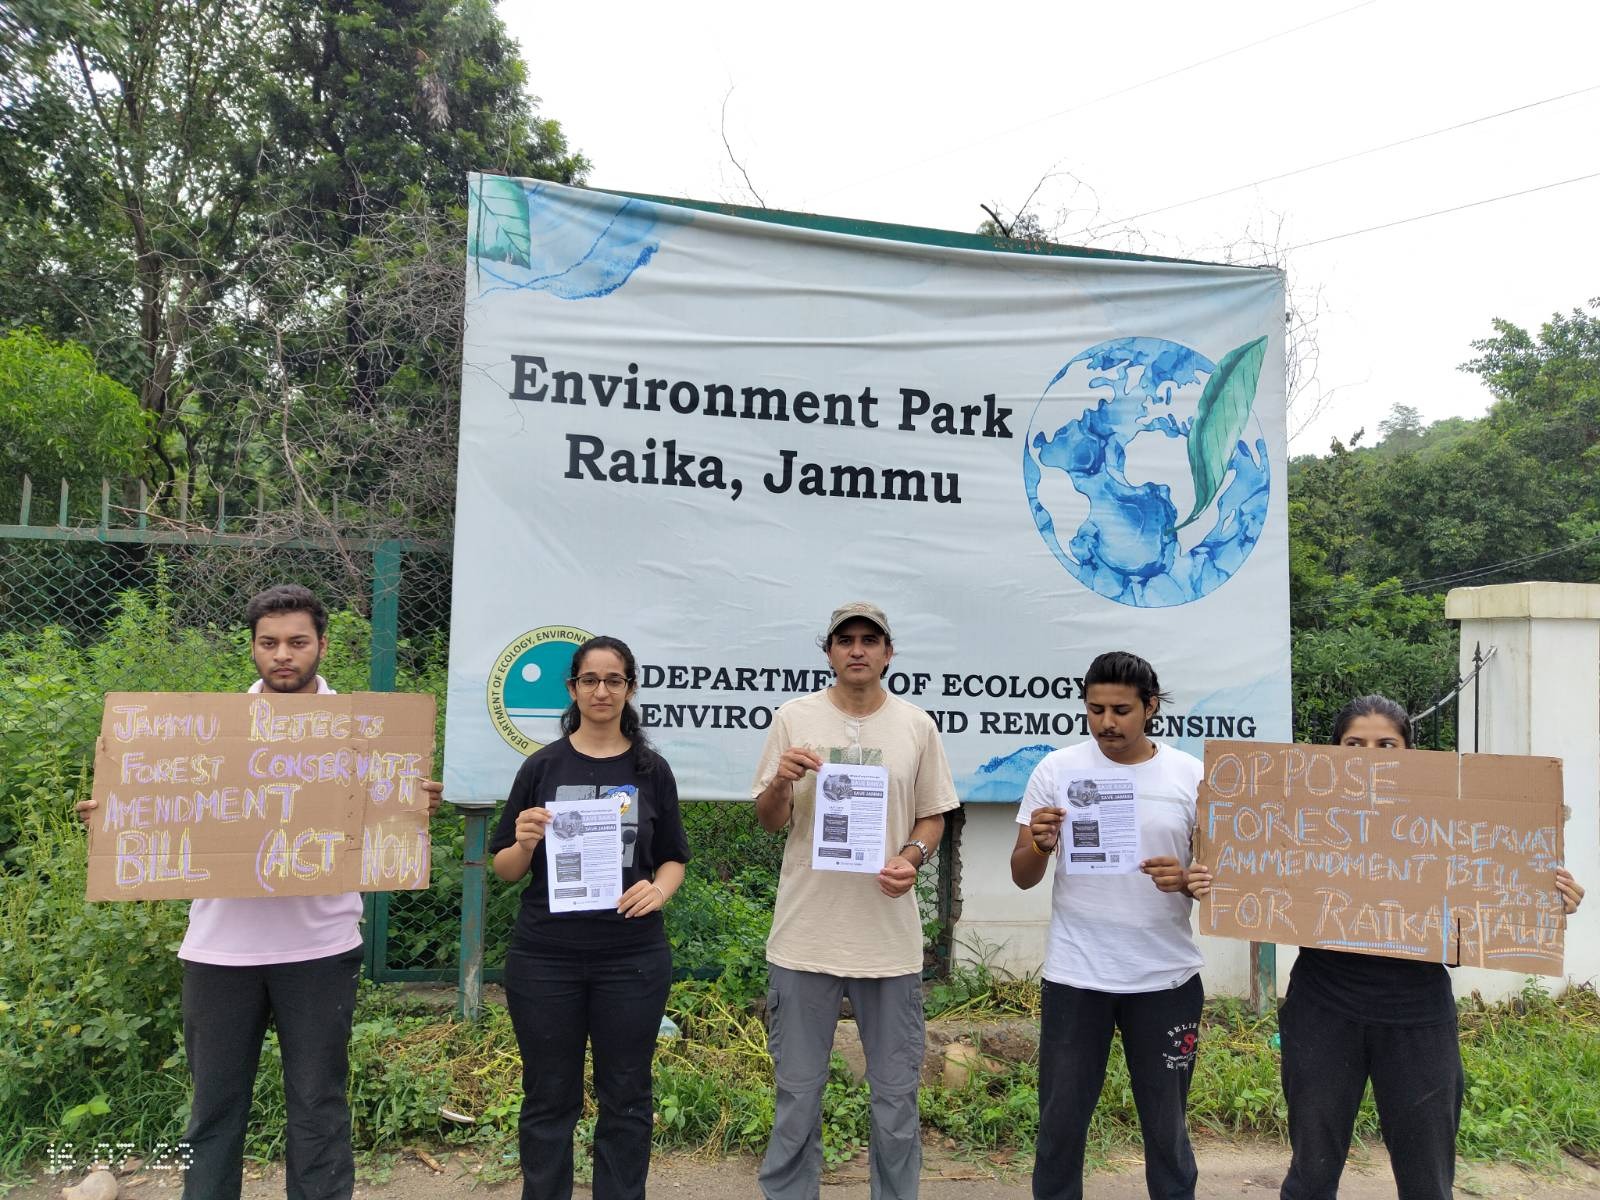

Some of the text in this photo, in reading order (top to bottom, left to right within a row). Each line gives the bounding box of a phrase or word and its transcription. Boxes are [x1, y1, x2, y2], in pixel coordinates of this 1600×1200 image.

[509, 354, 1013, 438] Environment Park
[564, 433, 962, 504] Raika, Jammu
[492, 630, 591, 749] DEPARTMENT OF ECOLOGY, ENVIRONM
[641, 664, 832, 692] DEPARTME
[888, 672, 931, 695] OF
[641, 703, 1257, 738] ENVIRO ND REMOT ENSING
[1208, 749, 1401, 805] OPPOSE
[102, 783, 302, 832] AMENDMENT
[1206, 801, 1380, 850] FOREST
[115, 827, 211, 889] BILL
[1209, 883, 1298, 936] FOR
